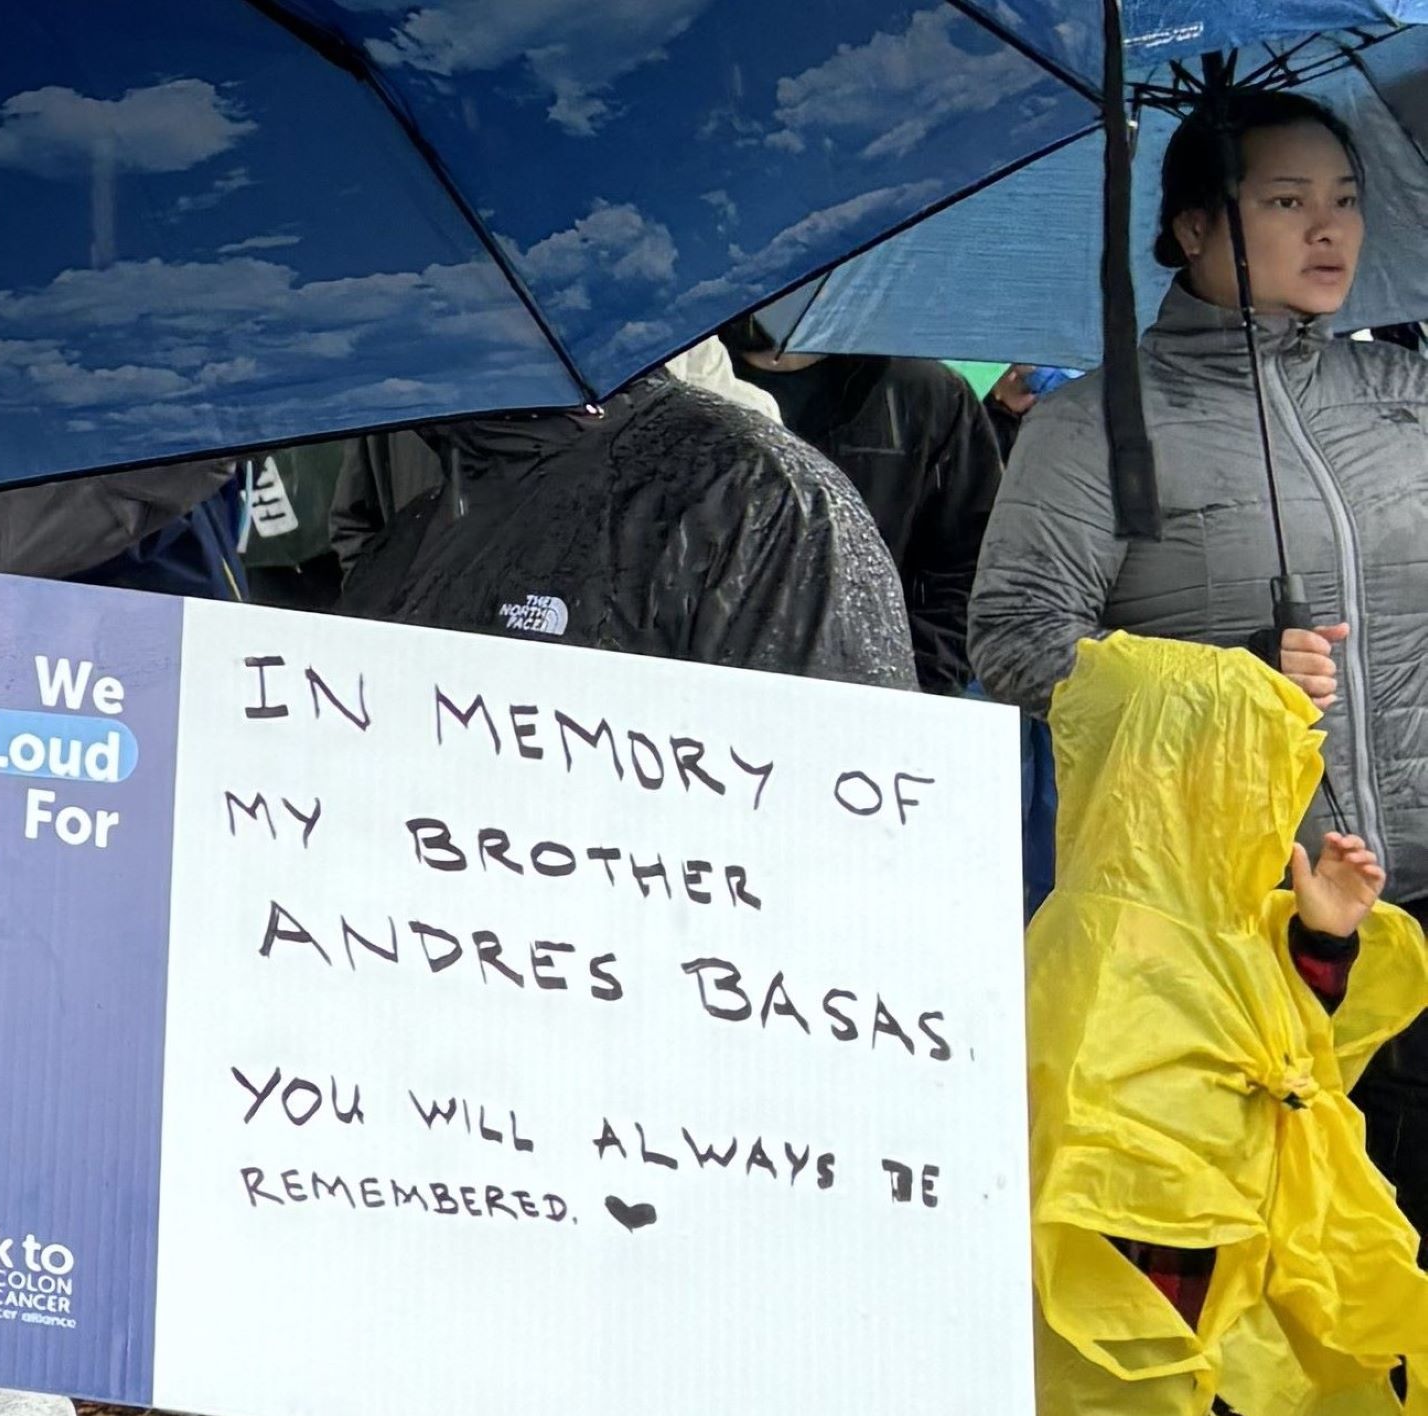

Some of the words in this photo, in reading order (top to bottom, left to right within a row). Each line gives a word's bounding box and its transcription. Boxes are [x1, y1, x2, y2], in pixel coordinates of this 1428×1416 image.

[499, 604, 546, 619] NORTH
[506, 616, 542, 632] FACE
[526, 594, 551, 607] THE
[35, 655, 124, 714] We
[244, 655, 372, 732] IN
[434, 683, 774, 810] MEMORY
[833, 769, 936, 824] OF
[24, 789, 120, 848] For
[225, 790, 322, 849] MY
[406, 816, 762, 910] BROTHER
[259, 901, 623, 1000] ANDRES
[231, 1066, 365, 1126] YOU
[409, 1089, 534, 1152] WILL
[593, 1116, 835, 1190] ALWAYS
[882, 1157, 940, 1208] BE
[22, 1233, 74, 1275] to
[21, 1311, 76, 1329] alliance
